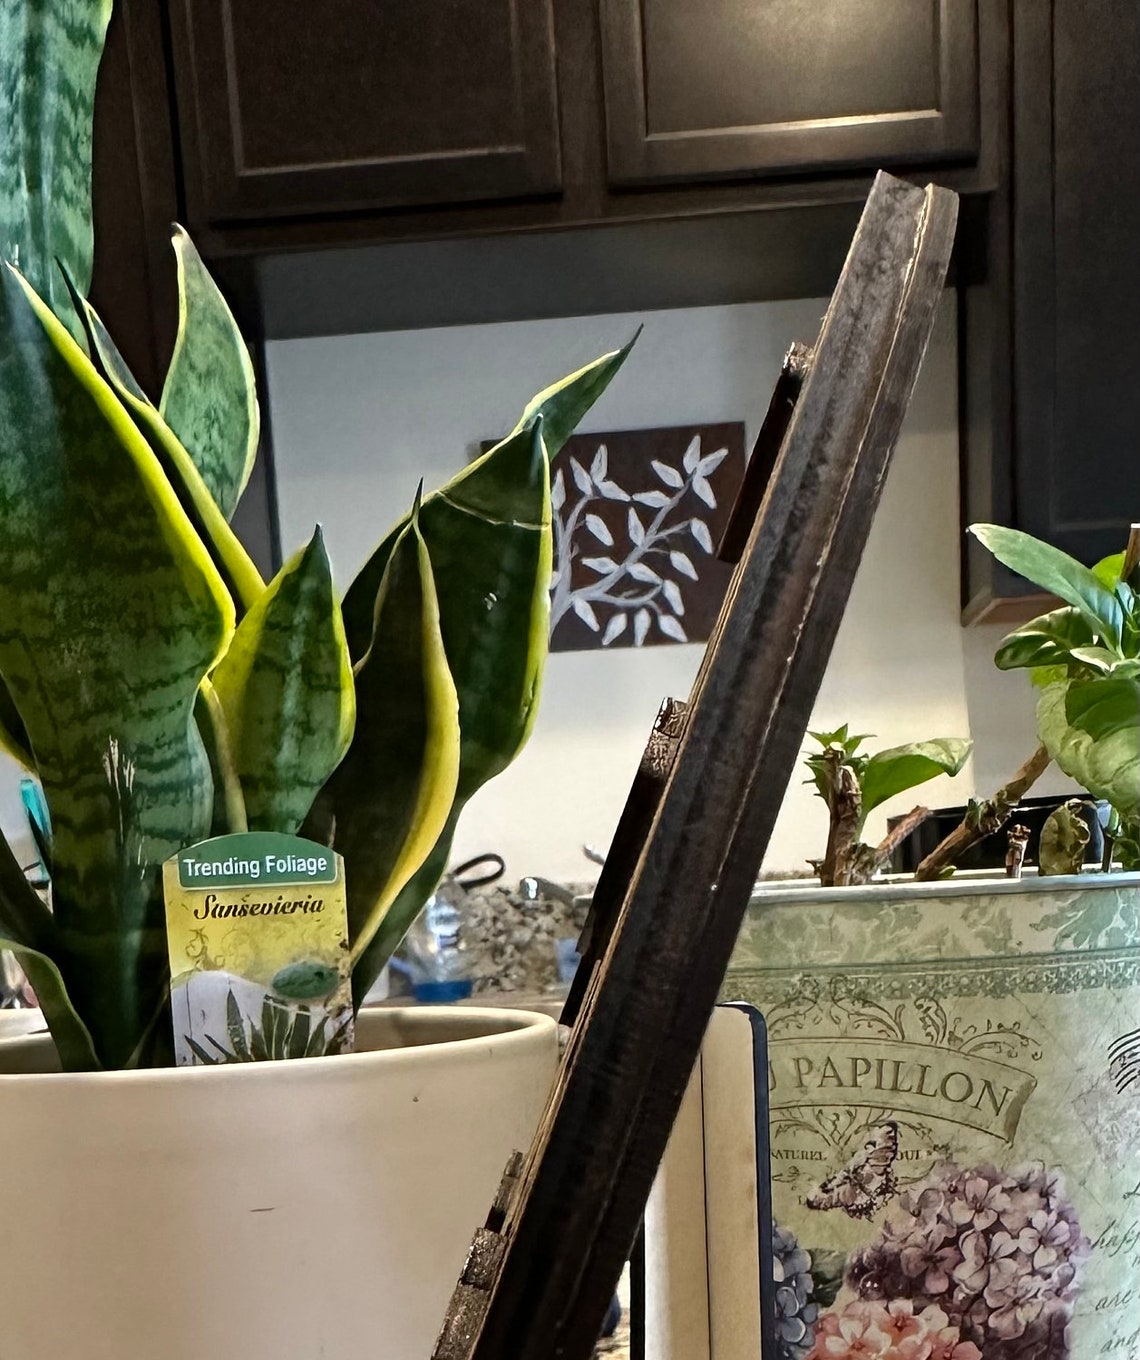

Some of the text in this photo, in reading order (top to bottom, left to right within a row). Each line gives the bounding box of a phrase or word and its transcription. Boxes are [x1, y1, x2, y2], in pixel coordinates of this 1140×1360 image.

[183, 855, 327, 878] Trending Foliage
[194, 894, 325, 920] Sansevieria
[793, 1055, 1012, 1116] PAPILLON
